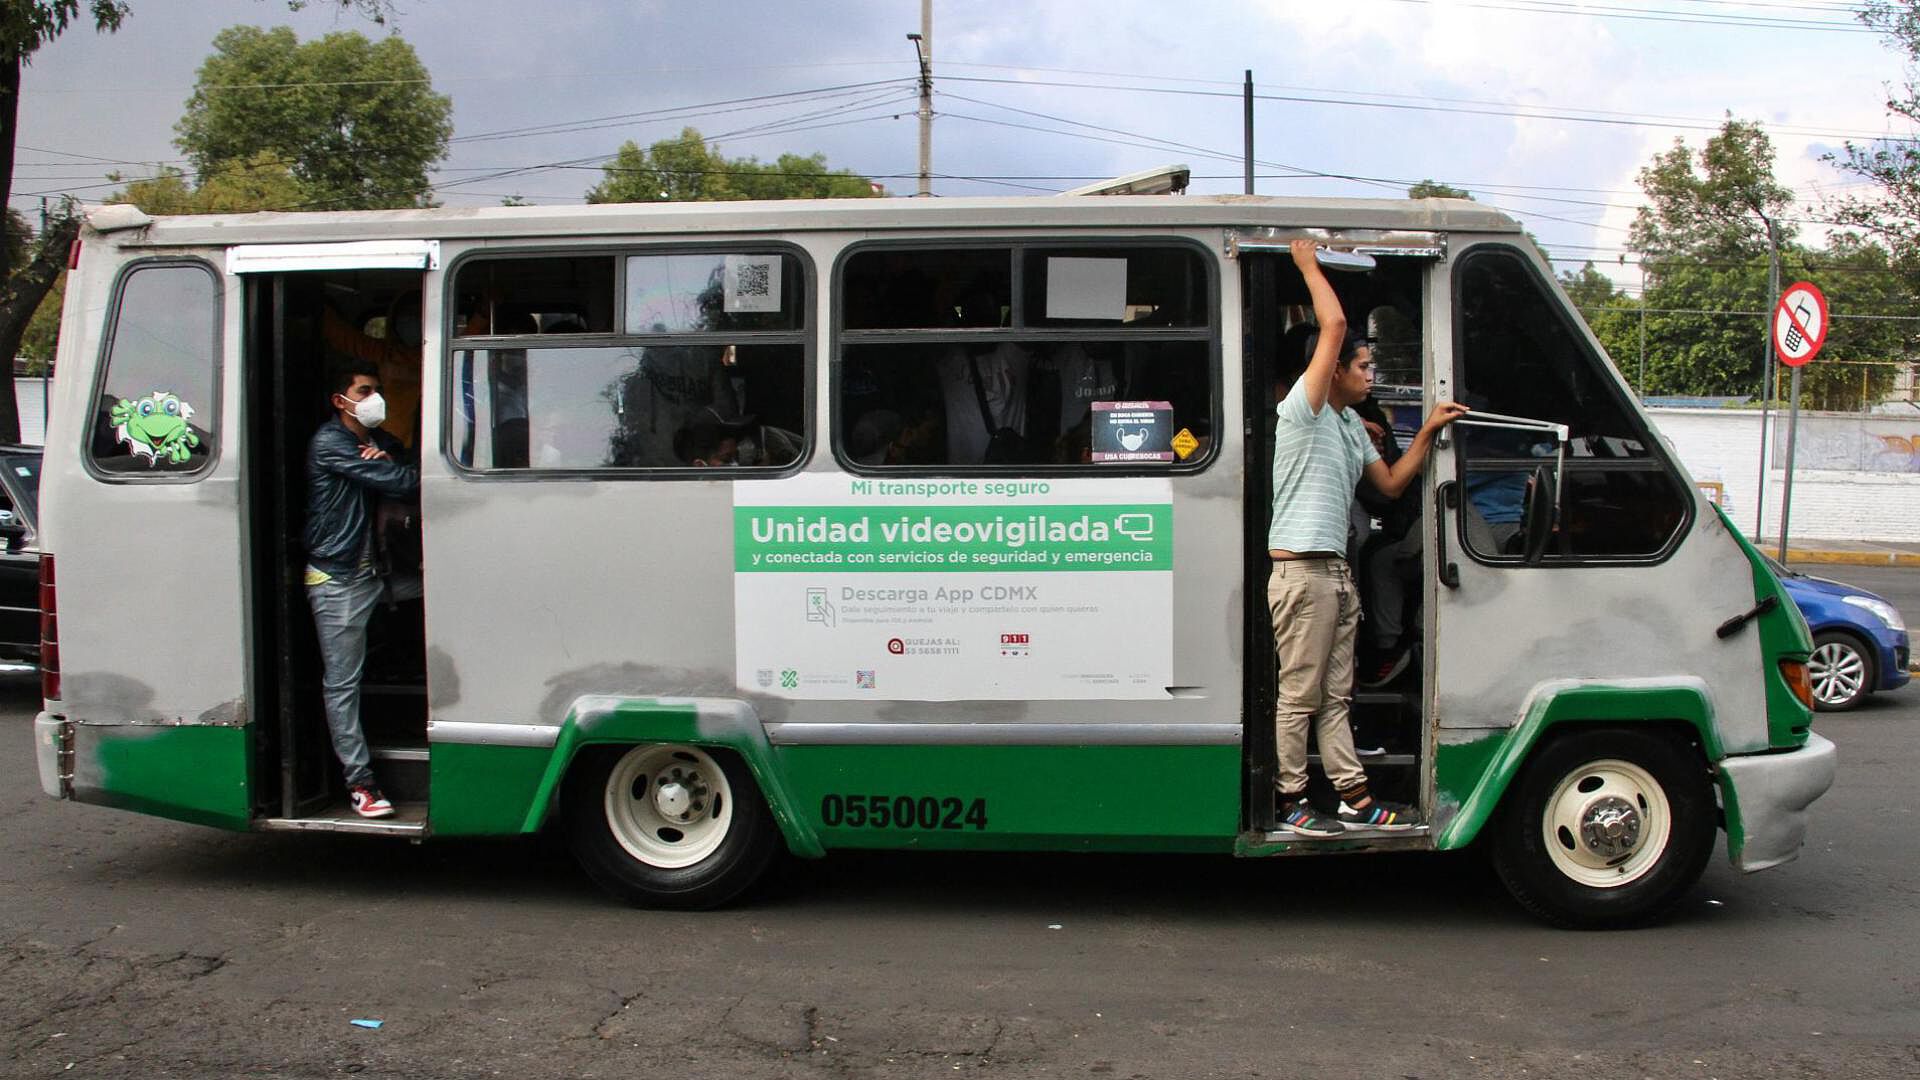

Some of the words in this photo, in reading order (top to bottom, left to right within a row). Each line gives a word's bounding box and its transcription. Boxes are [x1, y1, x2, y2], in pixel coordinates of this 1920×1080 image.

[1104, 453, 1118, 461] USA
[851, 481, 874, 495] Mi
[879, 481, 977, 497] transporte
[984, 481, 1050, 497] seguro
[751, 517, 869, 543] Unidad
[881, 516, 1109, 547] videovigilada
[752, 553, 761, 564] y
[765, 551, 843, 563] conectada
[848, 553, 874, 563] con
[879, 551, 944, 563] servicios
[949, 551, 968, 563] de
[972, 550, 1047, 565] seguridad
[1052, 553, 1060, 565] y
[1065, 550, 1153, 565] emergencia
[842, 587, 928, 603] Descarga
[935, 587, 974, 603] App
[980, 586, 1038, 601] CDMX
[905, 638, 943, 646] QUEJAS
[1002, 634, 1028, 643] 911
[821, 793, 988, 831] 0550024
